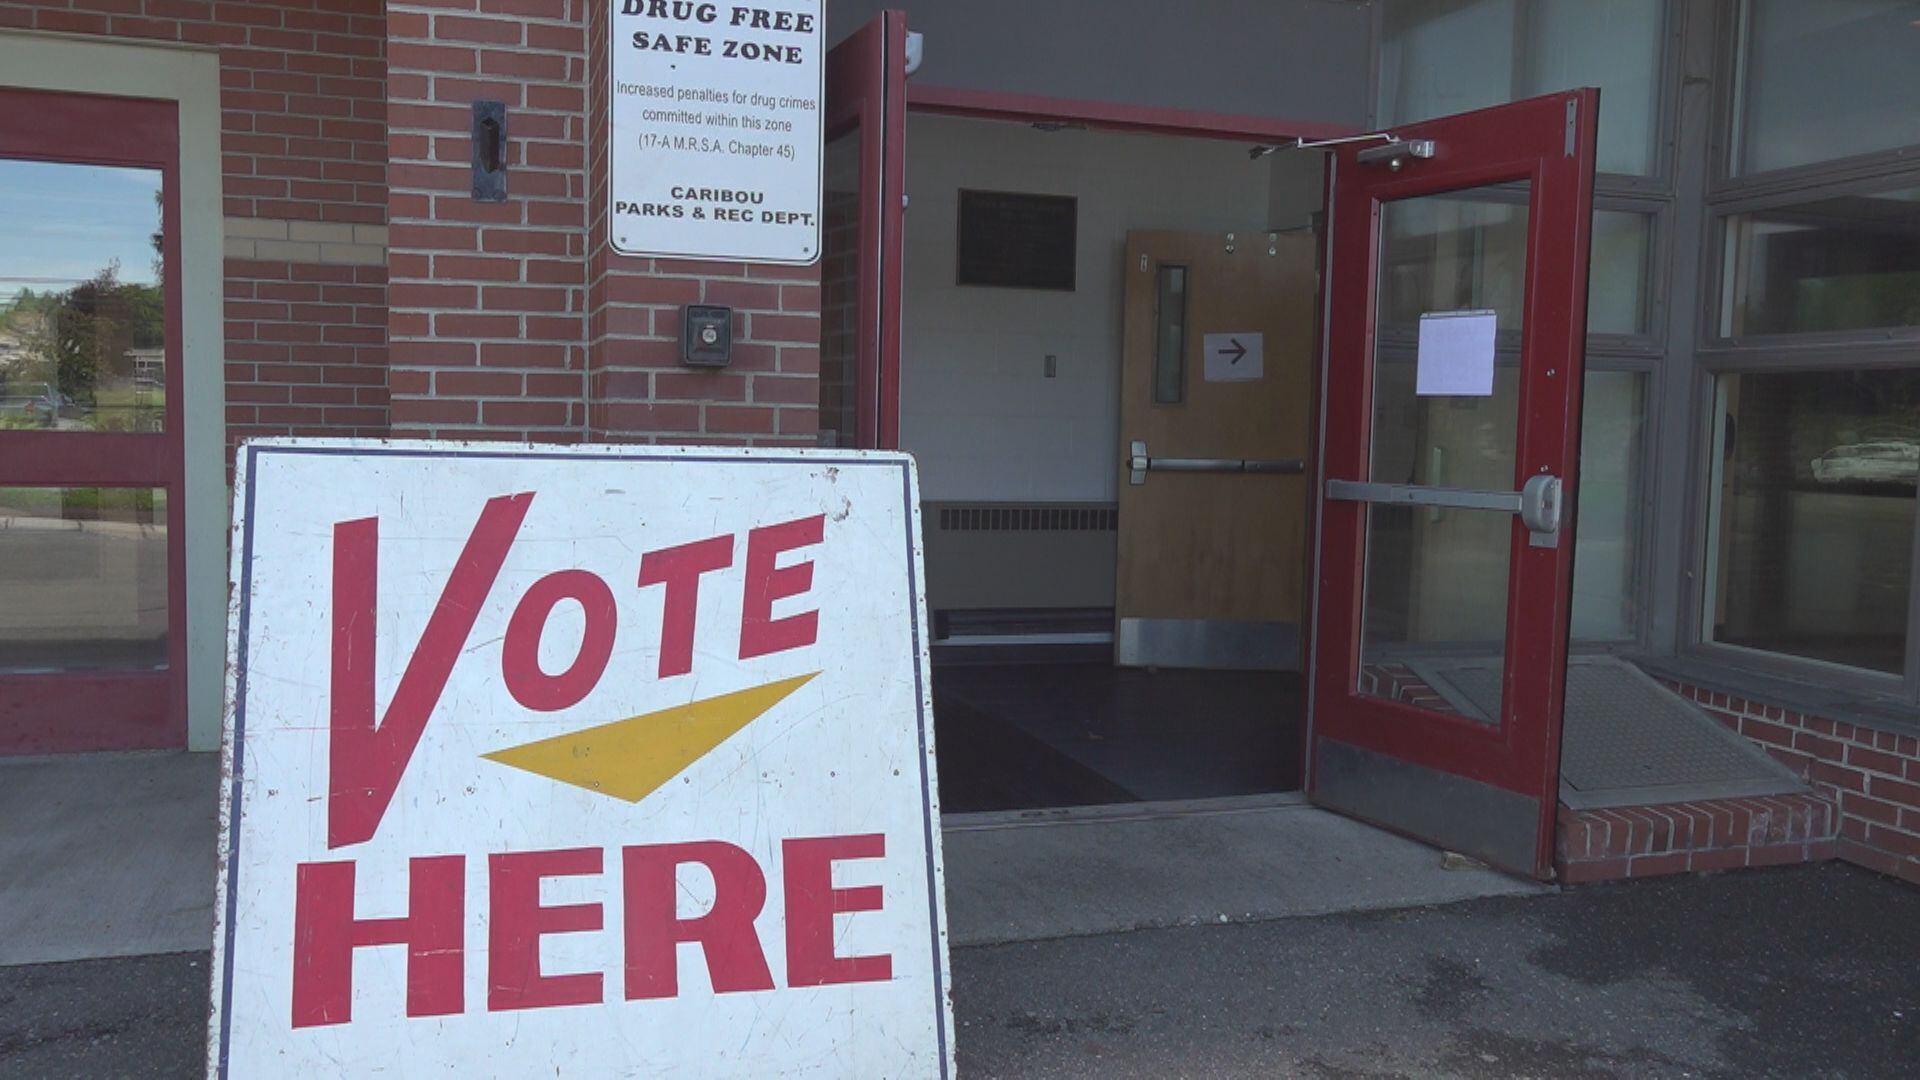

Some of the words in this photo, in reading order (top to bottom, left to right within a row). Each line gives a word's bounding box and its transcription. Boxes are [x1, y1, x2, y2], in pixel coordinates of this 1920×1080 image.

[621, 0, 718, 23] DRUG
[729, 7, 814, 33] FREE
[632, 31, 711, 56] SAFE
[722, 40, 803, 64] ZONE
[617, 80, 674, 98] Increased
[677, 88, 729, 104] penalties
[732, 90, 747, 104] for
[750, 92, 775, 110] drug
[779, 95, 816, 110] crimes
[642, 108, 702, 124] committed
[705, 112, 738, 128] within
[741, 115, 762, 130] this
[764, 119, 792, 132] zone
[638, 133, 670, 150] (17-A
[673, 136, 725, 153] M.R.S.A.
[728, 139, 773, 158] Chapter
[776, 144, 795, 161] 45)
[671, 186, 764, 204] CARIBOU
[615, 201, 685, 219] PARKS
[692, 207, 706, 220] &
[714, 208, 754, 222] REC
[761, 211, 816, 226] DEPT.
[328, 491, 826, 850] VOTE
[291, 833, 894, 1030] HERE
